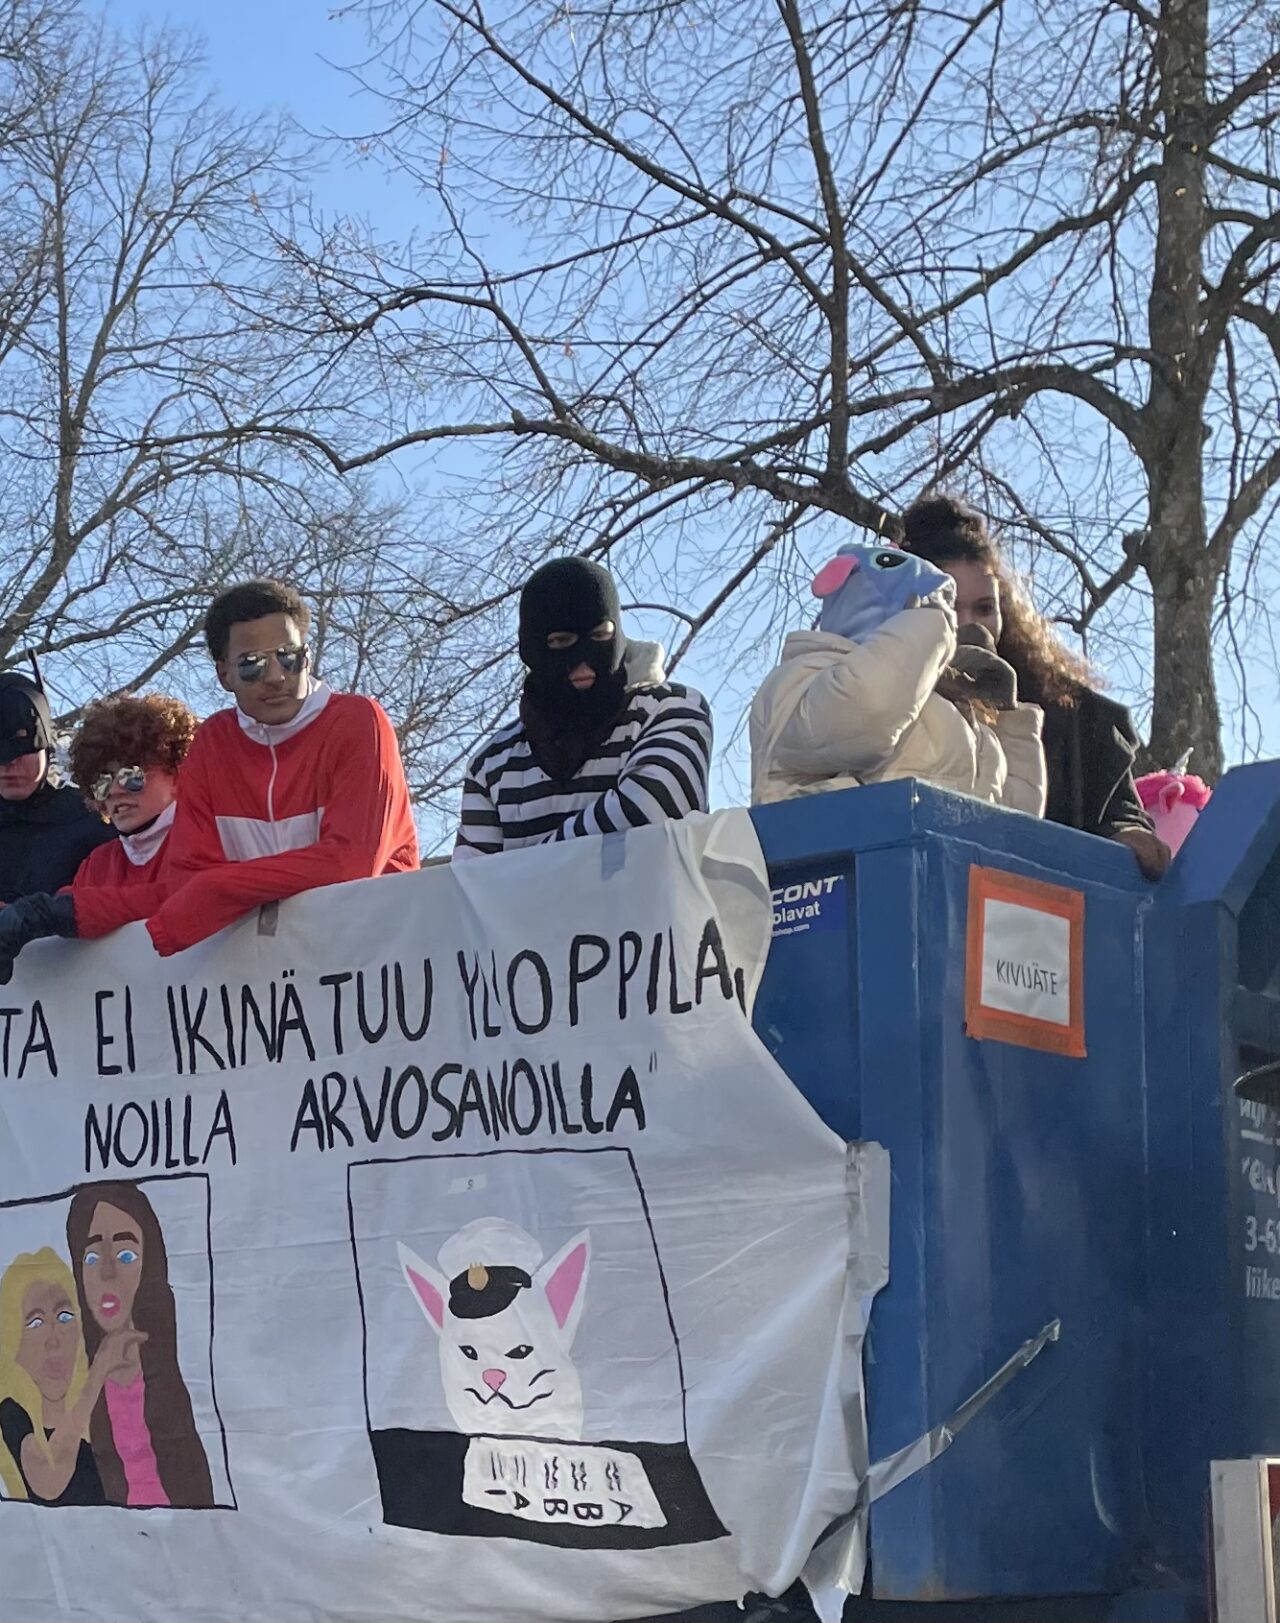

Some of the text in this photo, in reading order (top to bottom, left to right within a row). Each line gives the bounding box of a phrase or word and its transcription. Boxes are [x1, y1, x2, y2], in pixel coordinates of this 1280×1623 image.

[95, 984, 136, 1076] EI
[167, 968, 316, 1075] IKINÄ
[320, 958, 433, 1055] TUU
[996, 959, 1058, 995] KIVIJÄTE
[85, 1089, 237, 1173] NOILLA
